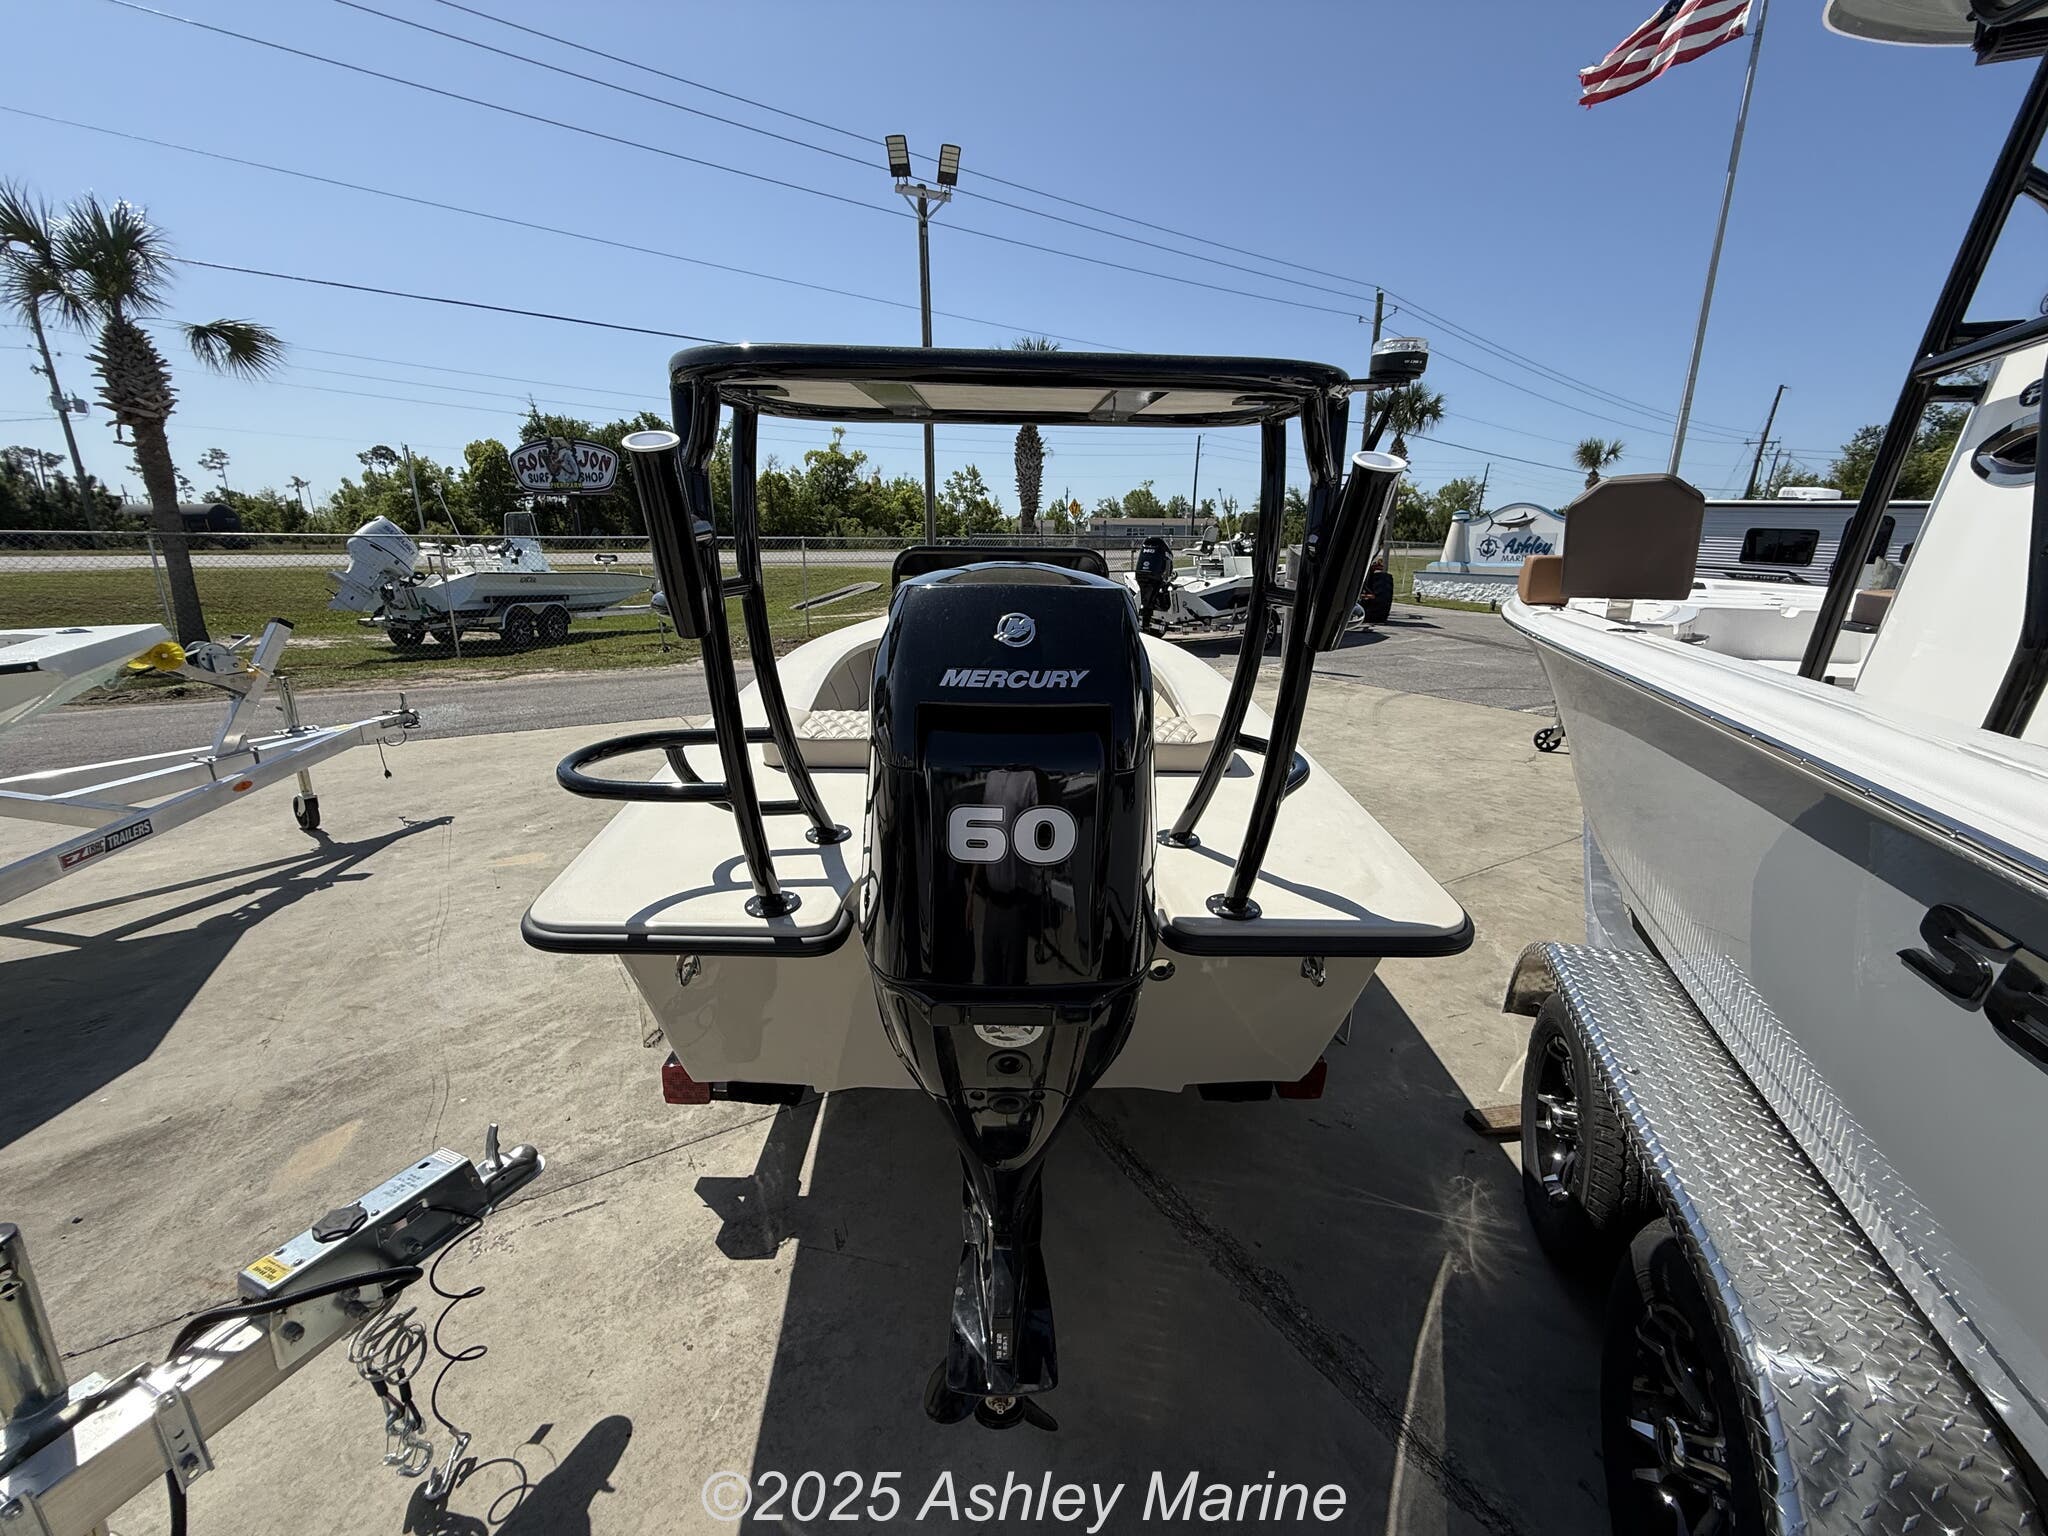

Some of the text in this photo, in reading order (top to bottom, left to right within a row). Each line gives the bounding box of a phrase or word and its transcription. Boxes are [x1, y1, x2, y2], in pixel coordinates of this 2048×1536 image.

[577, 450, 612, 472] JON
[527, 471, 604, 483] SURF SHOP
[1502, 535, 1553, 556] Ashley
[939, 669, 1090, 688] MERCURY
[107, 821, 151, 849] TRAILERS
[946, 804, 1078, 865] 60
